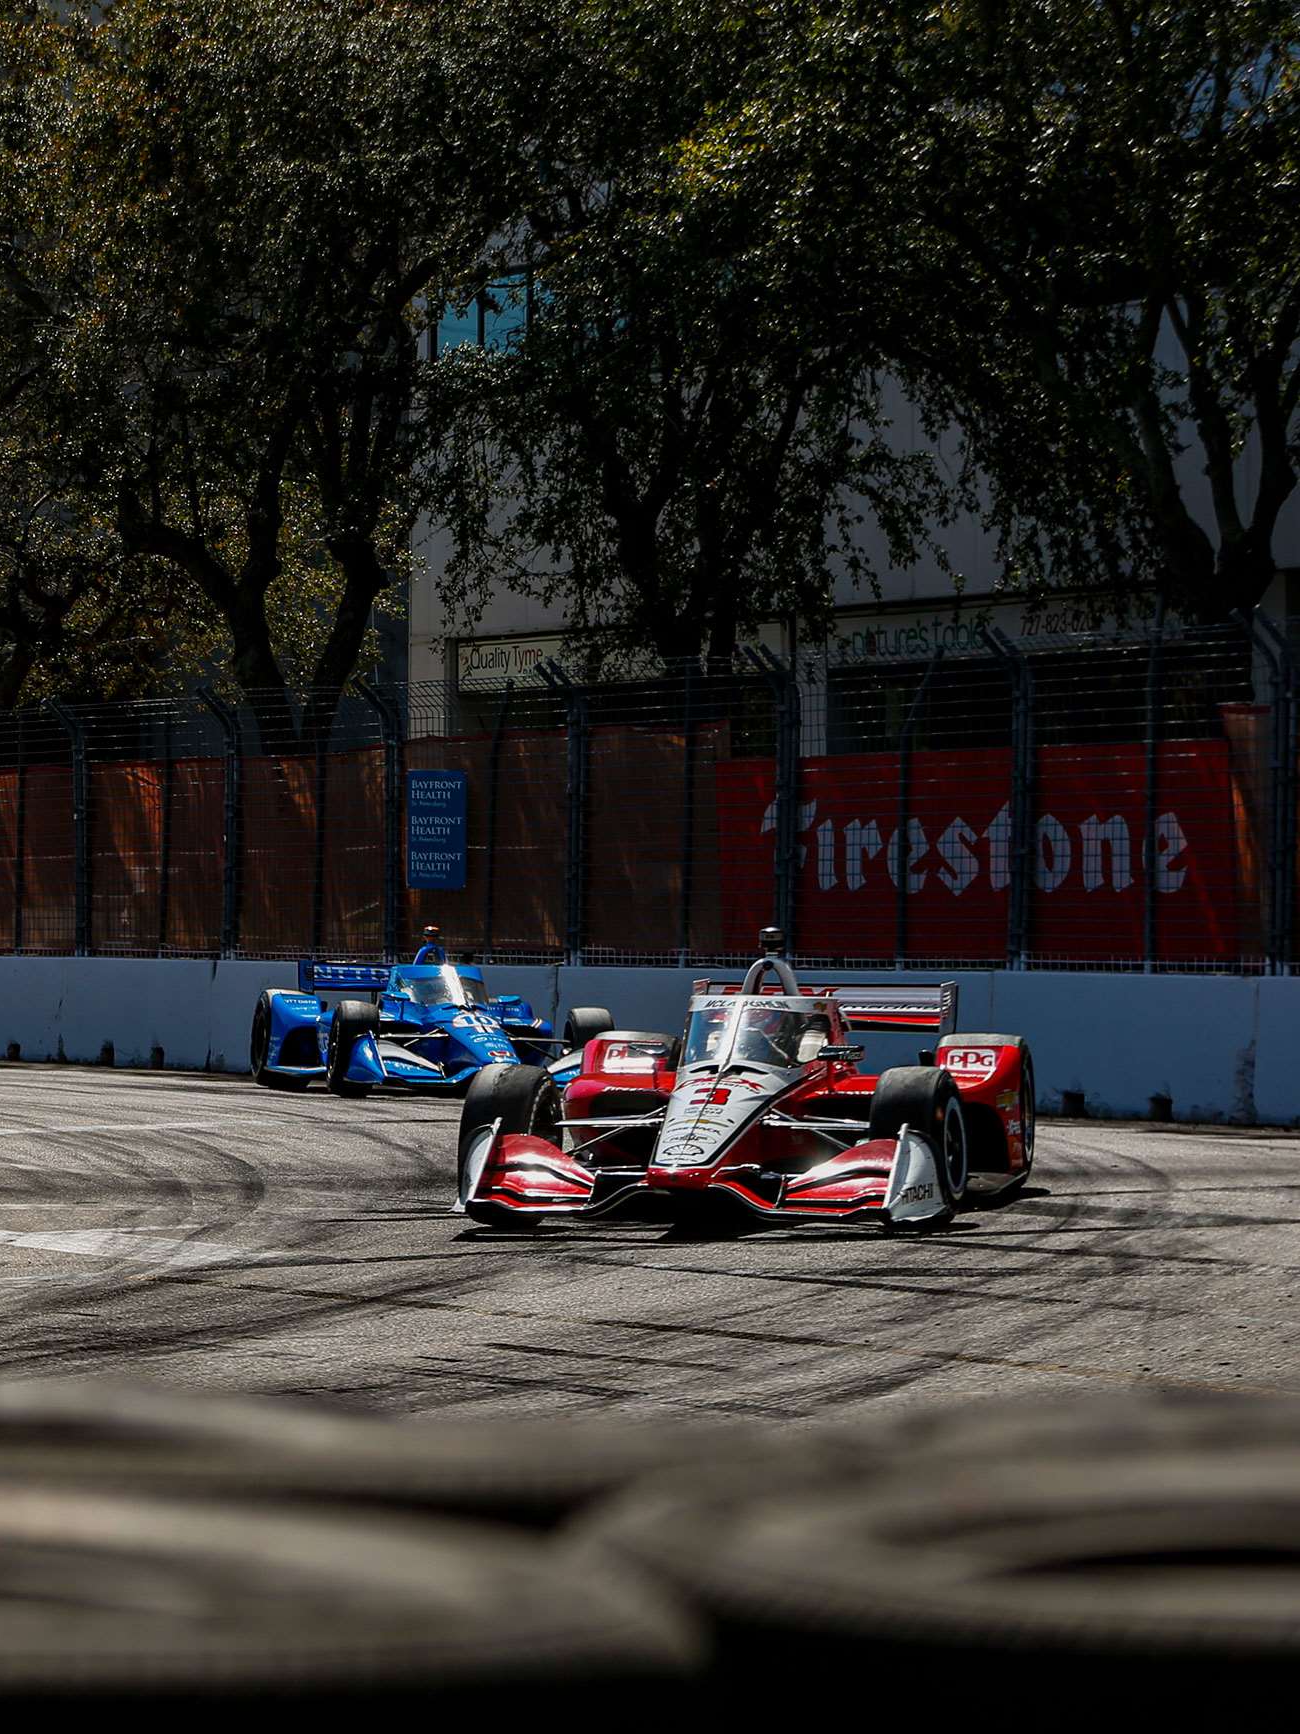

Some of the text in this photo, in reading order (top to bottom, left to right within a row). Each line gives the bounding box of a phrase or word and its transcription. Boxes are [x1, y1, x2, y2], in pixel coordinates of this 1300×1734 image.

[470, 646, 543, 674] Quality Tyme
[411, 780, 462, 790] BAYFRONT
[411, 790, 451, 800] HEALTH
[411, 815, 462, 825] BAYFRONT
[411, 825, 450, 835] HEALTH
[411, 851, 462, 861] BAYFRONT
[411, 861, 451, 871] HEALTH
[949, 1051, 994, 1068] PPG
[690, 1087, 731, 1105] 3
